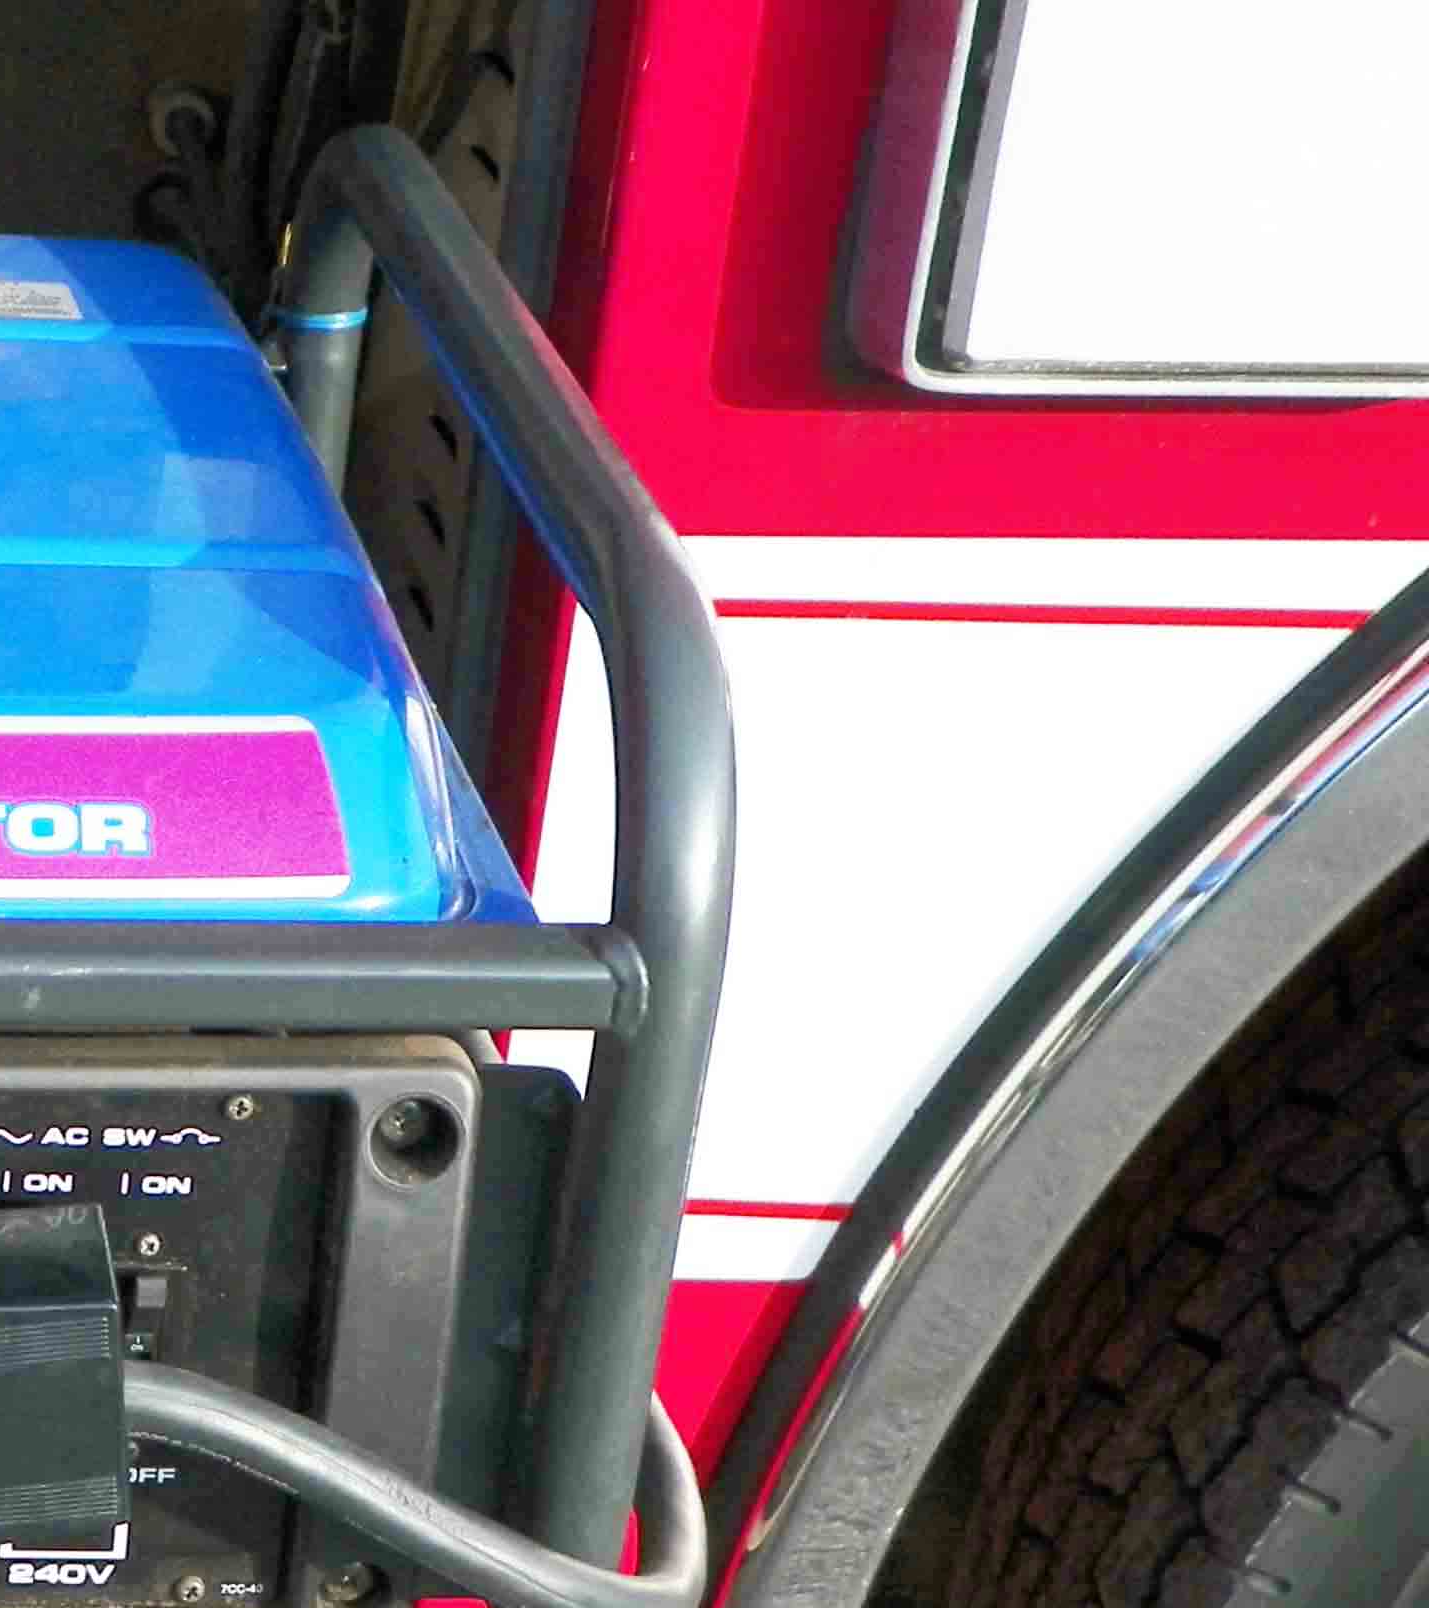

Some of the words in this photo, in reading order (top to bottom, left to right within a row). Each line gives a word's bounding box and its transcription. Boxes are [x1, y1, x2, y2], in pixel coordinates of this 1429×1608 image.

[40, 1127, 89, 1146] AC
[102, 1127, 157, 1147] SW
[23, 1173, 73, 1193] ON
[141, 1175, 192, 1195] ON
[8, 1563, 115, 1585] 240V
